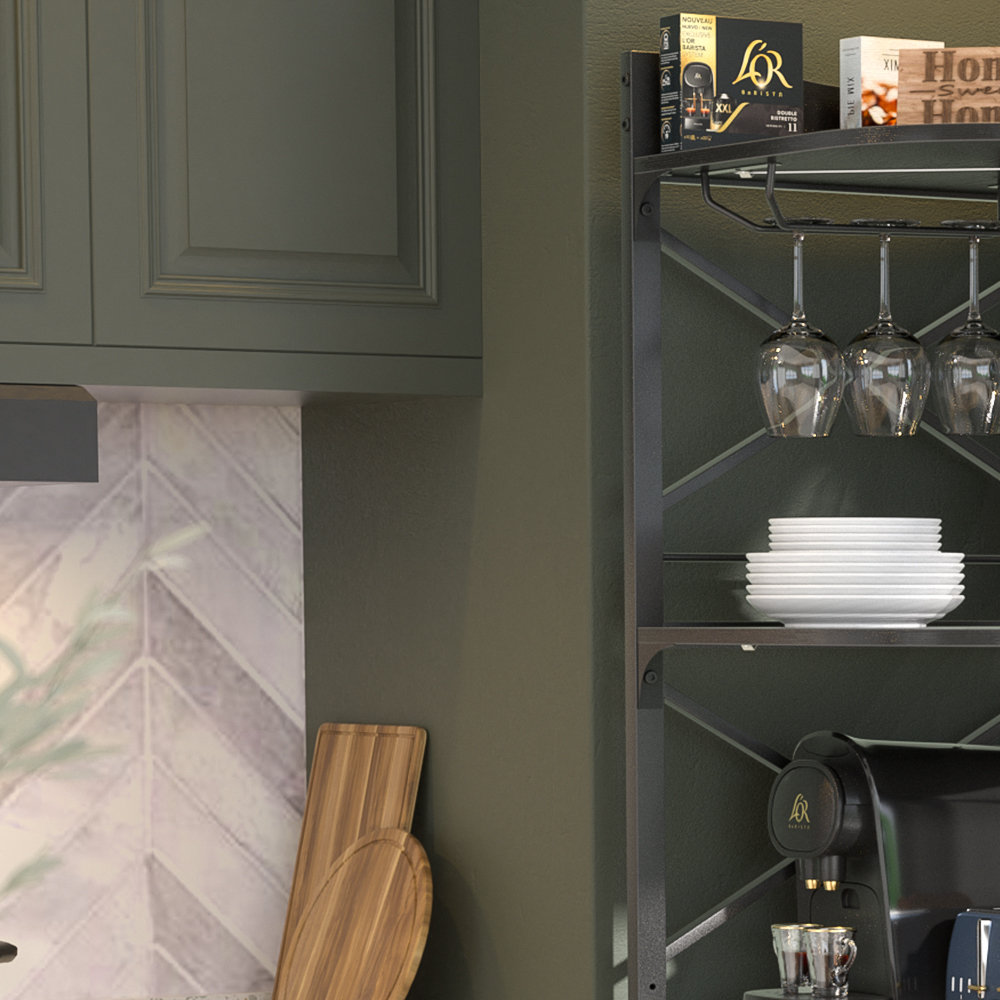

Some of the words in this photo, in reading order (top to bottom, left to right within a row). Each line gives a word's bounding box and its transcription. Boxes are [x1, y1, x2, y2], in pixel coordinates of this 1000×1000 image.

[732, 39, 793, 89] L'OR
[741, 89, 784, 98] BARISTA
[715, 103, 733, 114] XXL
[788, 123, 798, 132] 11
